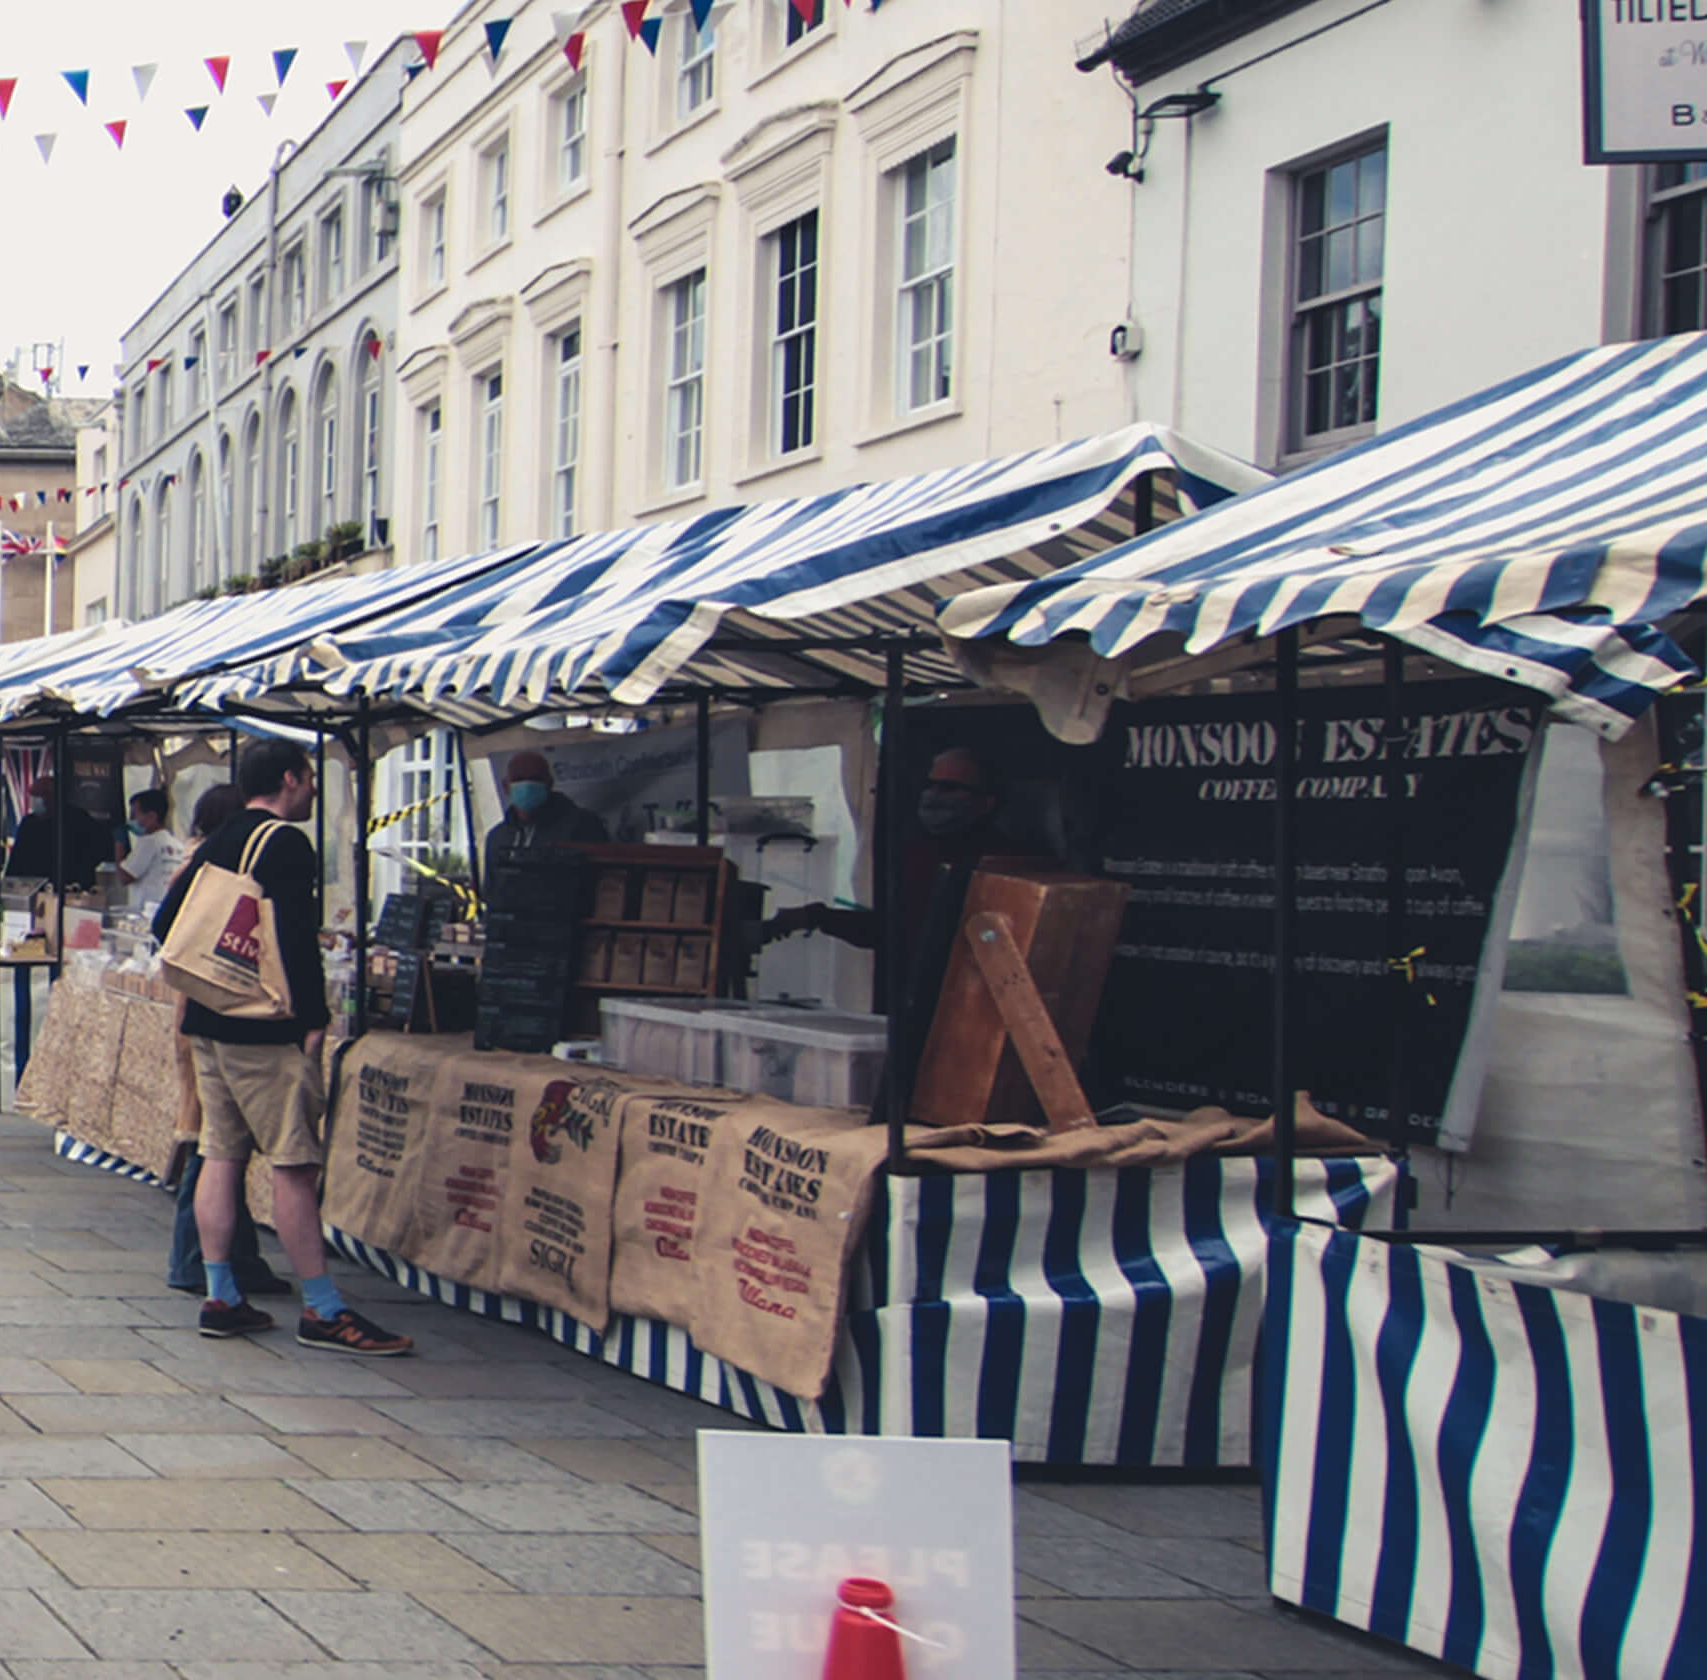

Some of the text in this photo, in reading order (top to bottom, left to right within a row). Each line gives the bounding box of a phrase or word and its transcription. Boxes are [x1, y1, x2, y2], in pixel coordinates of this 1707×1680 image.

[1124, 720, 1304, 768] MONSOO
[1198, 772, 1423, 800] COFFE COMPAY
